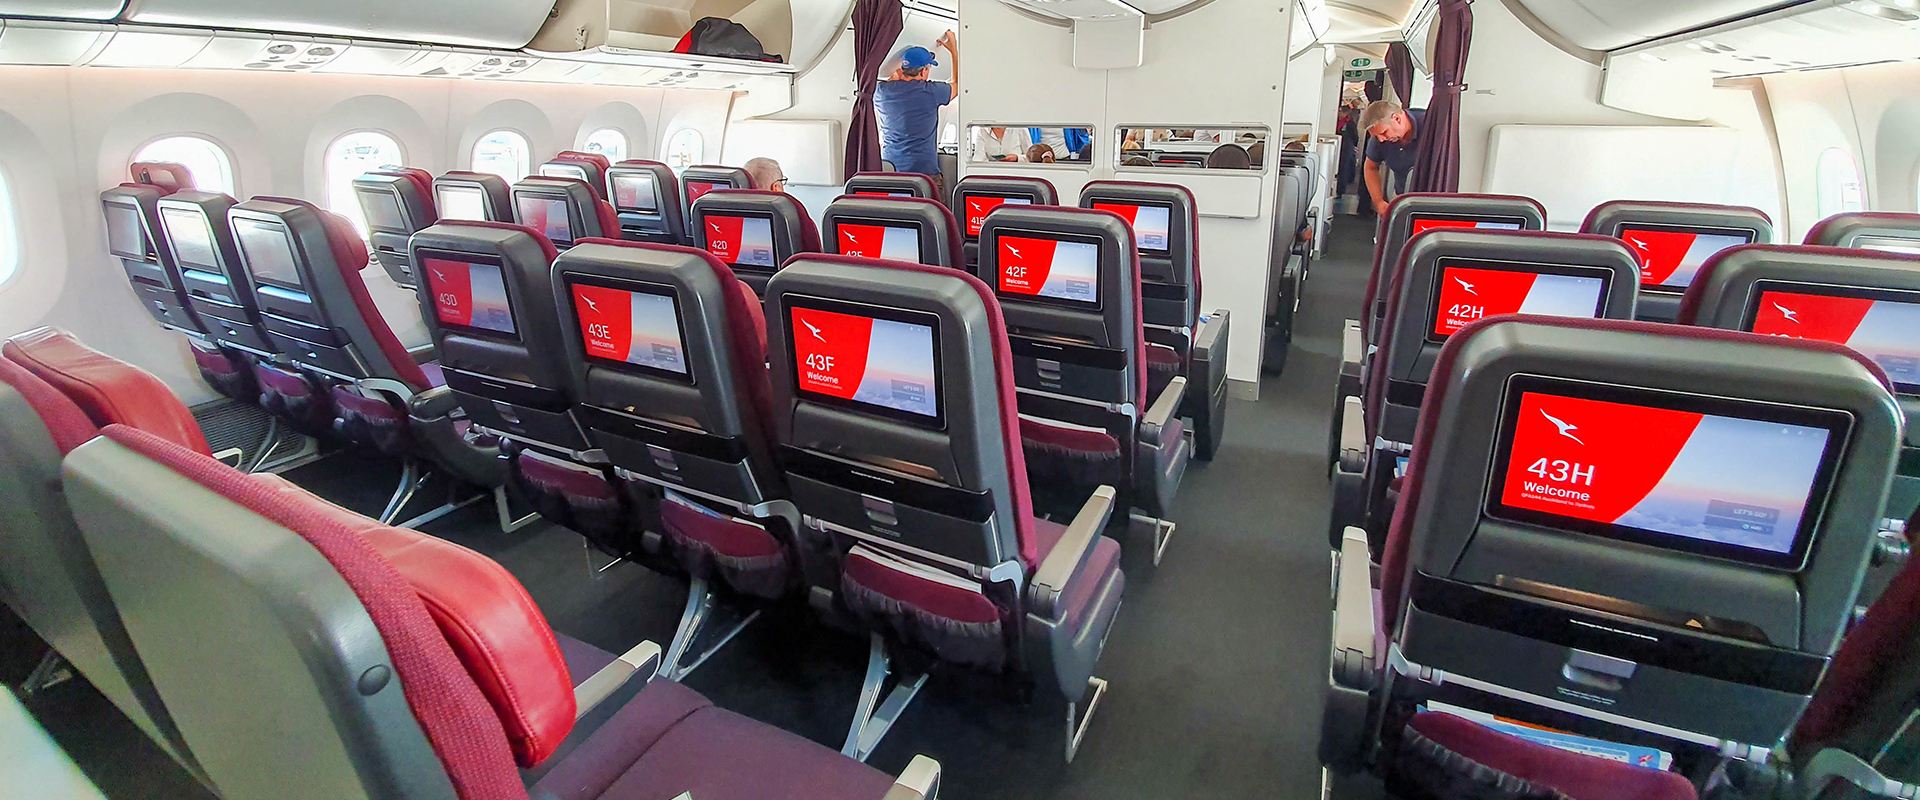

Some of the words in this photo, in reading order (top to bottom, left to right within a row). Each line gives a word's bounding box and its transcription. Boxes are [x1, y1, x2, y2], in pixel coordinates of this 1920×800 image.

[711, 240, 728, 250] 42D
[1005, 265, 1027, 278] 42F
[1005, 278, 1029, 286] Welcome
[439, 293, 458, 307] 43D
[1448, 303, 1484, 319] 42H
[588, 323, 611, 340] 43E
[590, 338, 615, 350] Welcome
[806, 353, 835, 372] 43F
[806, 371, 839, 385] Welcome
[1527, 457, 1595, 486] 43H
[1523, 481, 1590, 502] Welcome
